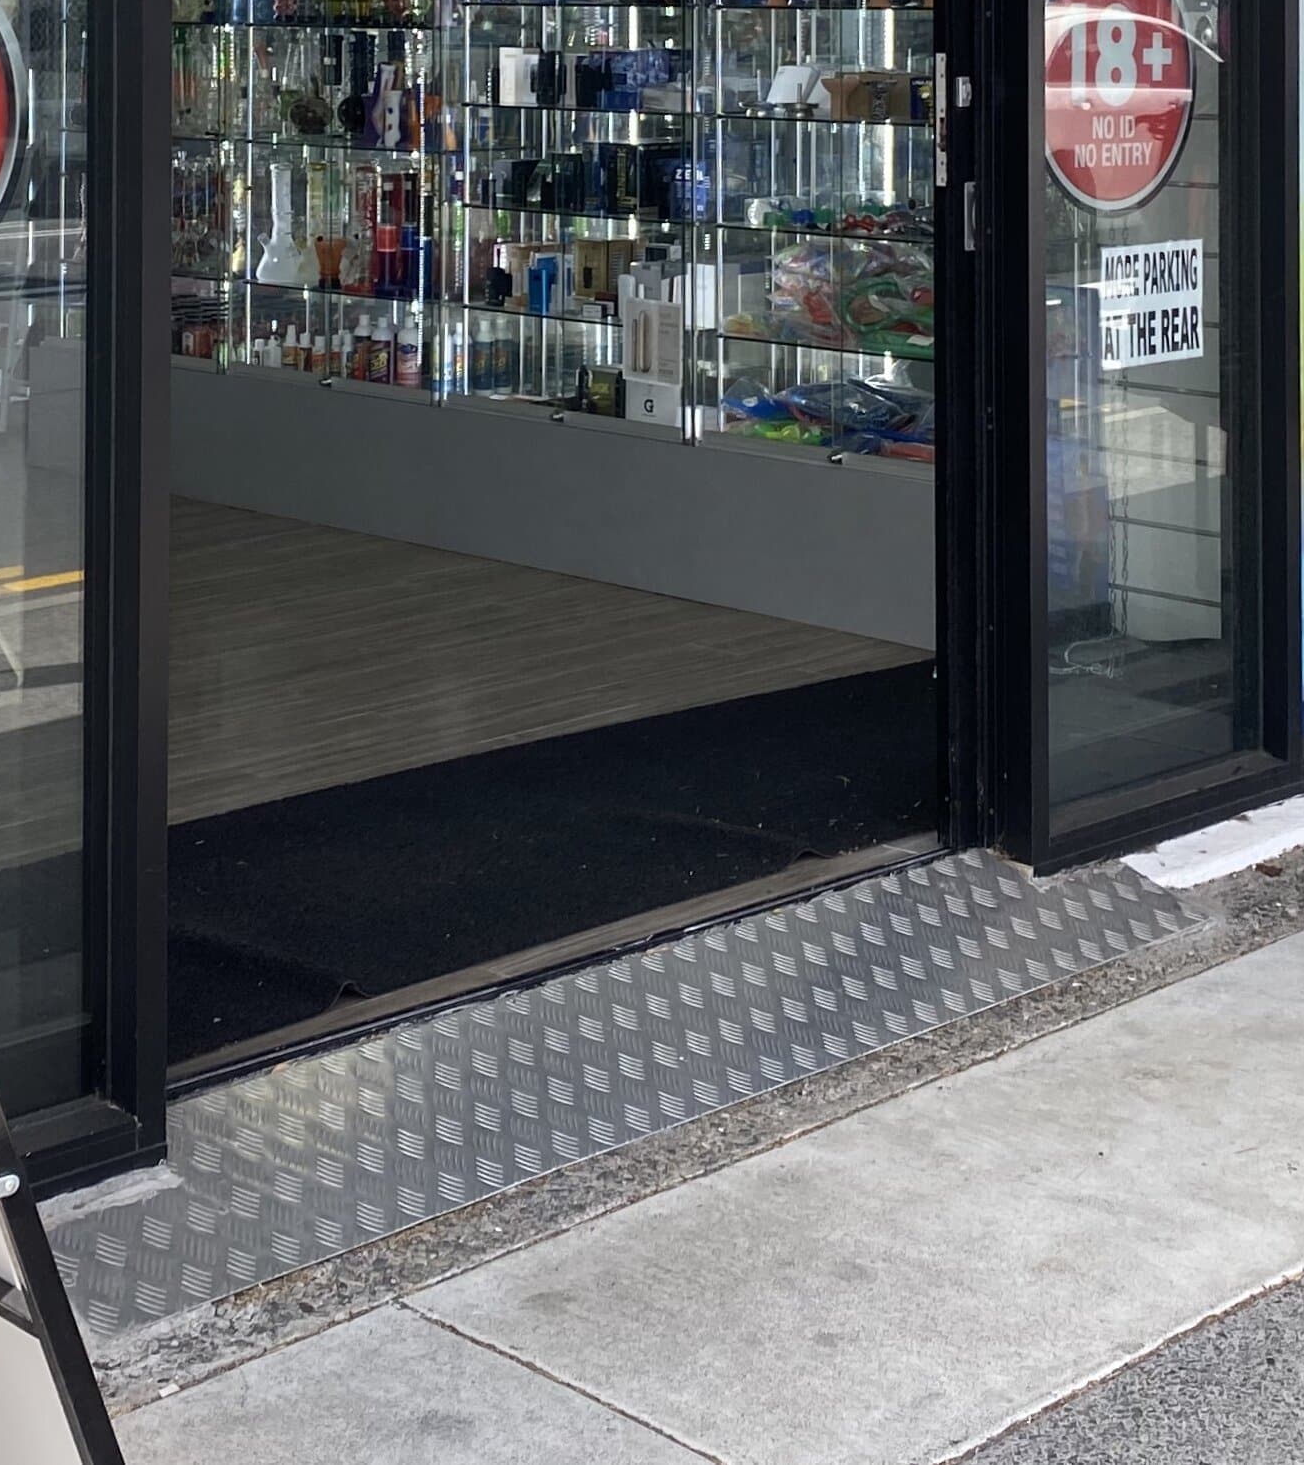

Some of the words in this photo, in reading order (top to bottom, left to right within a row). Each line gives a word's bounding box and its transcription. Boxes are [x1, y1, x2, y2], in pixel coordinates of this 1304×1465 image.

[1069, 1, 1173, 107] 18+
[1092, 115, 1114, 139] NO
[1119, 114, 1136, 138] ID
[1074, 143, 1097, 168] NO
[1101, 141, 1154, 167] ENTRY
[1104, 251, 1140, 299] MORE
[1143, 247, 1198, 296] PARKING
[1104, 315, 1124, 361] AT
[1128, 310, 1157, 356] THE
[1161, 305, 1201, 353] REAR
